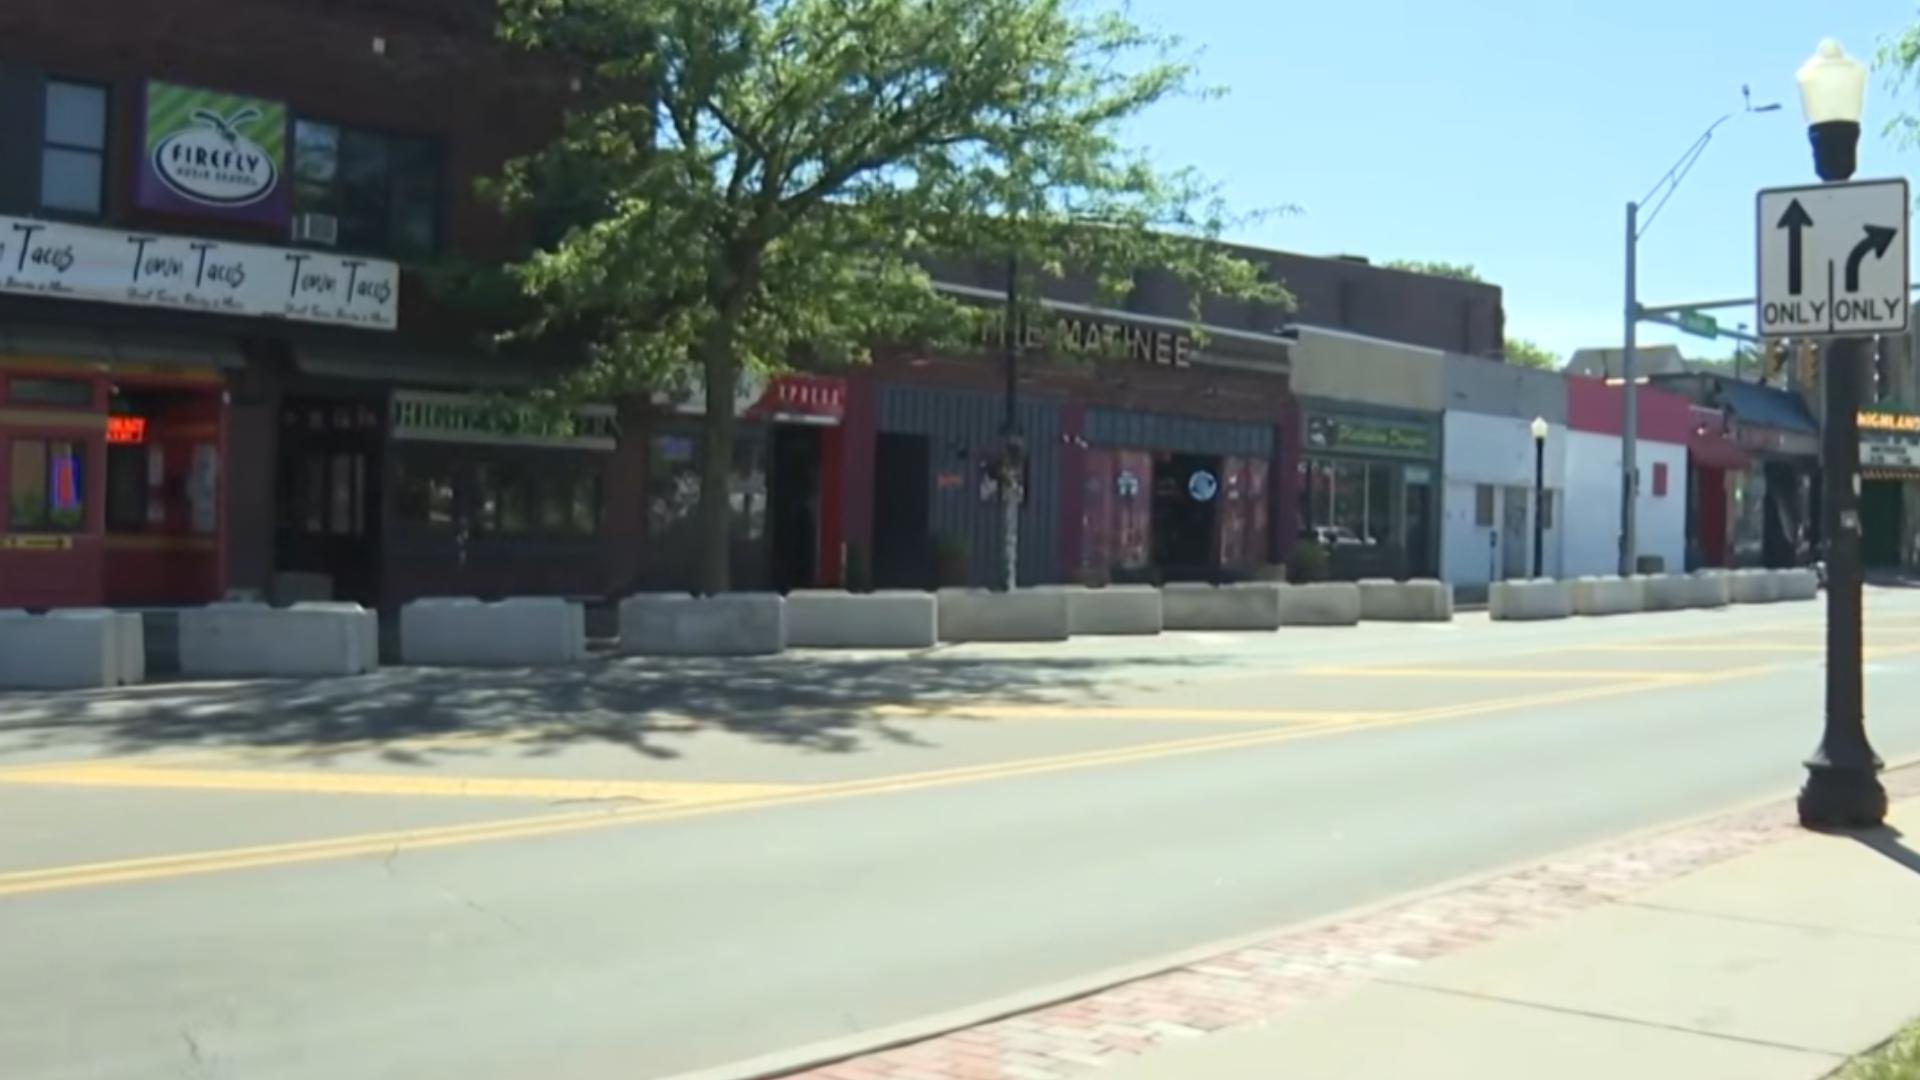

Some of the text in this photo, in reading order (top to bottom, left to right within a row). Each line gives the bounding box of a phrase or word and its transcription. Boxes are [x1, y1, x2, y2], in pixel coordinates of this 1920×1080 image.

[172, 143, 260, 173] FIREFLY
[13, 222, 74, 272] Tacos
[190, 241, 246, 289] Tacos
[341, 260, 391, 305] Tacos
[1763, 302, 1826, 325] ONLY
[1835, 298, 1900, 322] ONLY
[1056, 318, 1191, 369] MATINEE
